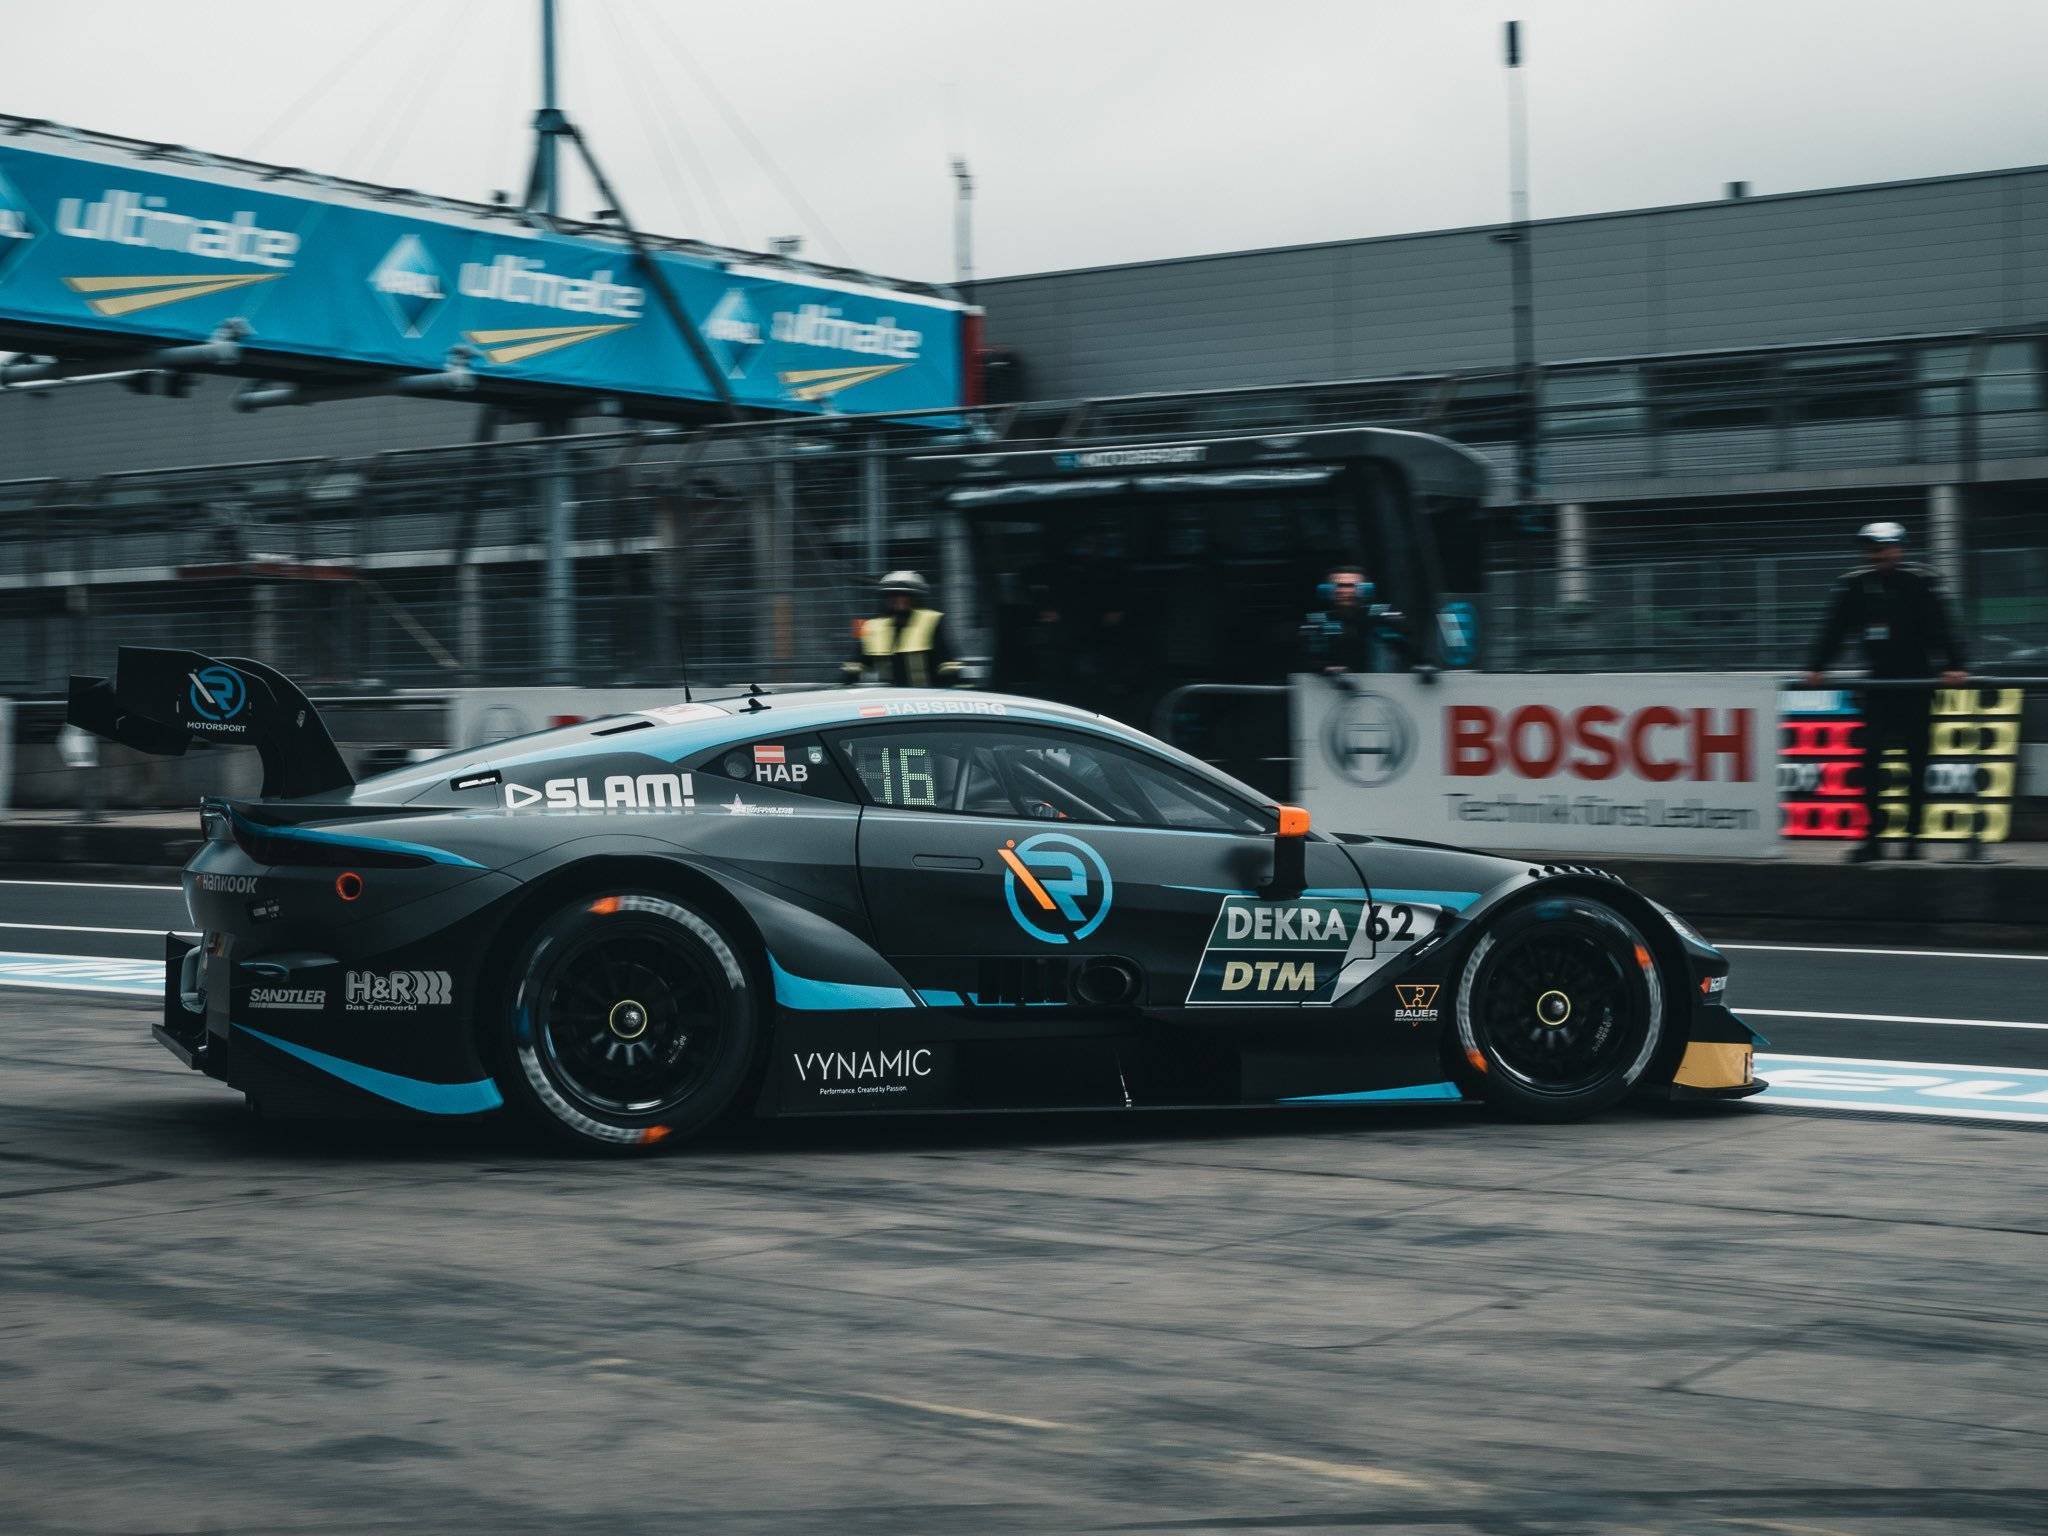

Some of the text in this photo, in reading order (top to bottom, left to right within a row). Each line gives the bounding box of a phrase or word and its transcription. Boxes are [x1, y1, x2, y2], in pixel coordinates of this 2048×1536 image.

[55, 189, 301, 267] ultimate
[457, 254, 646, 318] ultimate
[769, 303, 923, 358] ultimate
[884, 701, 1006, 716] HABSBURG
[186, 721, 247, 733] MOTORSPORT
[1442, 703, 1758, 783] BOSCH
[544, 772, 696, 808] SLAM!
[754, 764, 809, 783] HAB
[880, 747, 936, 806] 16
[1226, 906, 1349, 941] DEKRA
[1364, 904, 1416, 942] 62
[345, 970, 418, 1005] H&R
[1221, 961, 1316, 991] DTM
[249, 988, 328, 1004] SANDTLER
[1395, 1009, 1439, 1018] BAUER
[793, 1048, 932, 1081] VYNAMIC
[857, 1086, 879, 1094] Created
